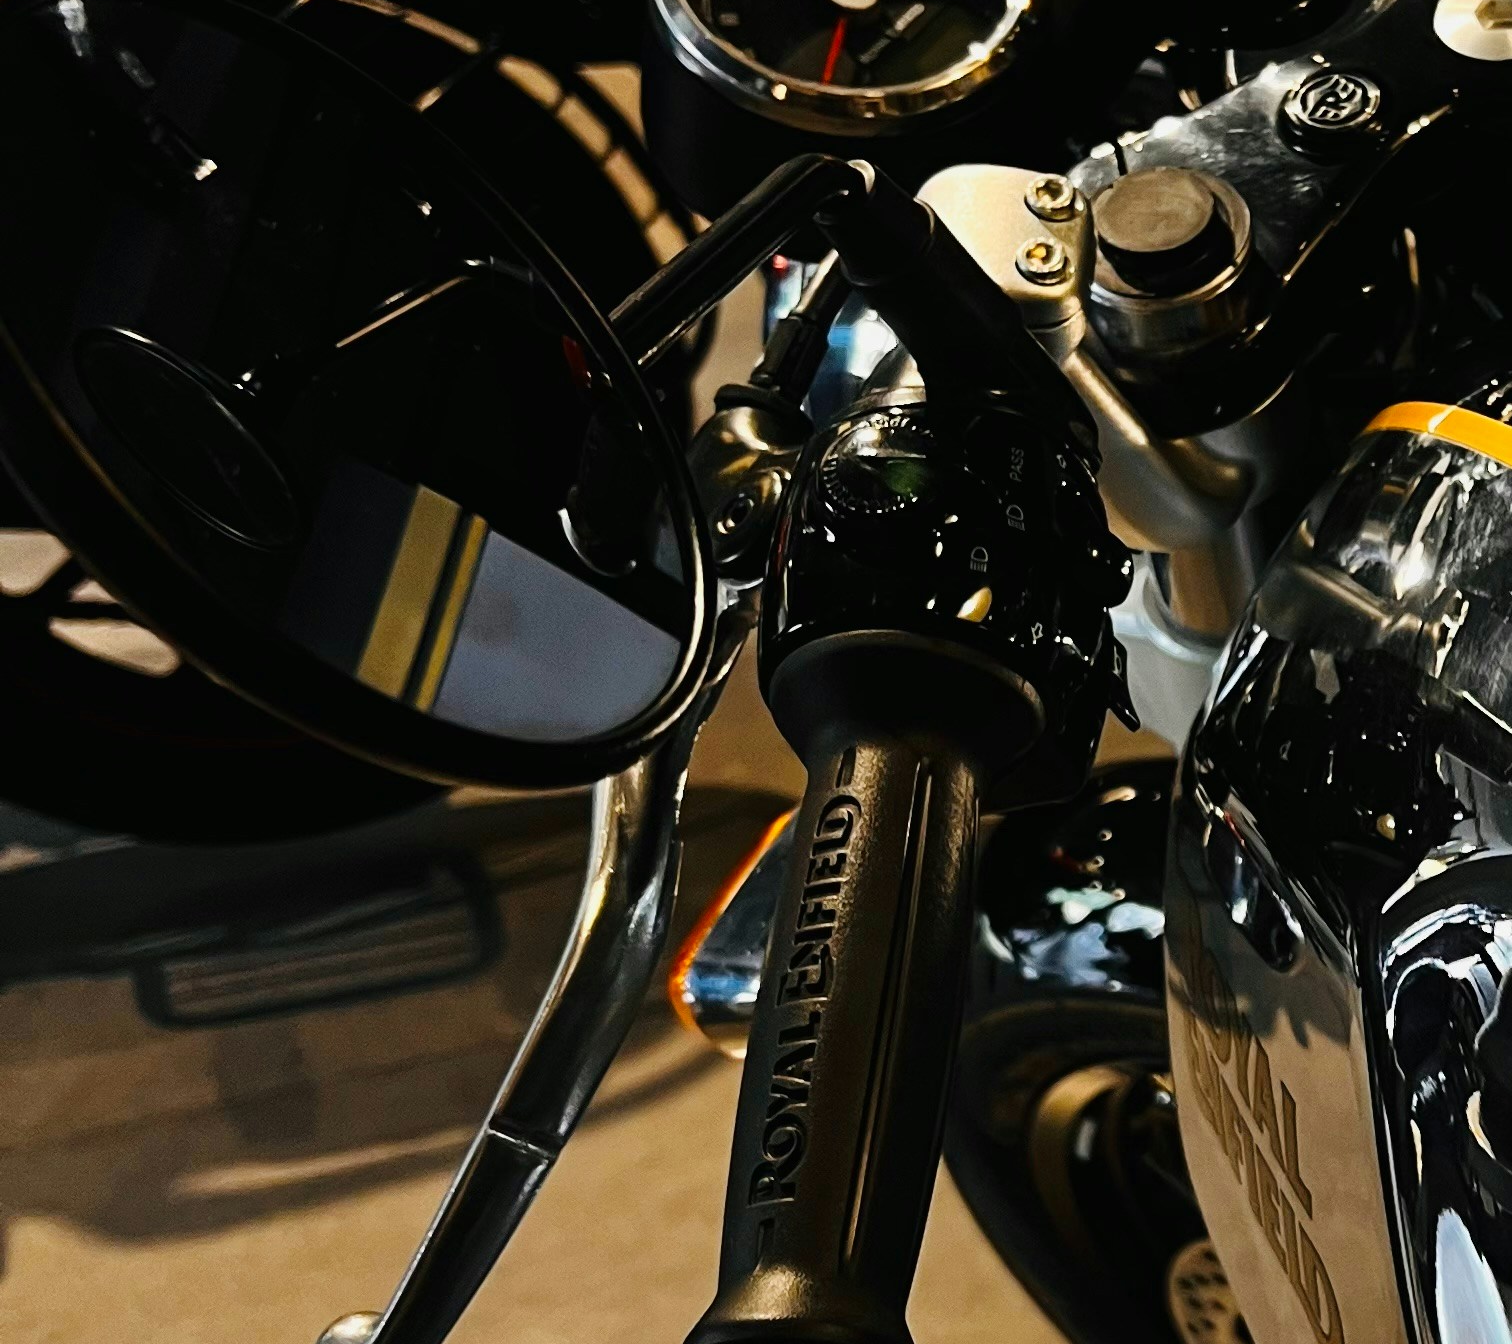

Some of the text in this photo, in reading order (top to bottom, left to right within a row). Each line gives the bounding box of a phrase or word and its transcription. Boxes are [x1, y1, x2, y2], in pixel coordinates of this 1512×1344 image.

[1009, 446, 1025, 482] PASS
[747, 794, 862, 1207] ROYAL ENFIELD
